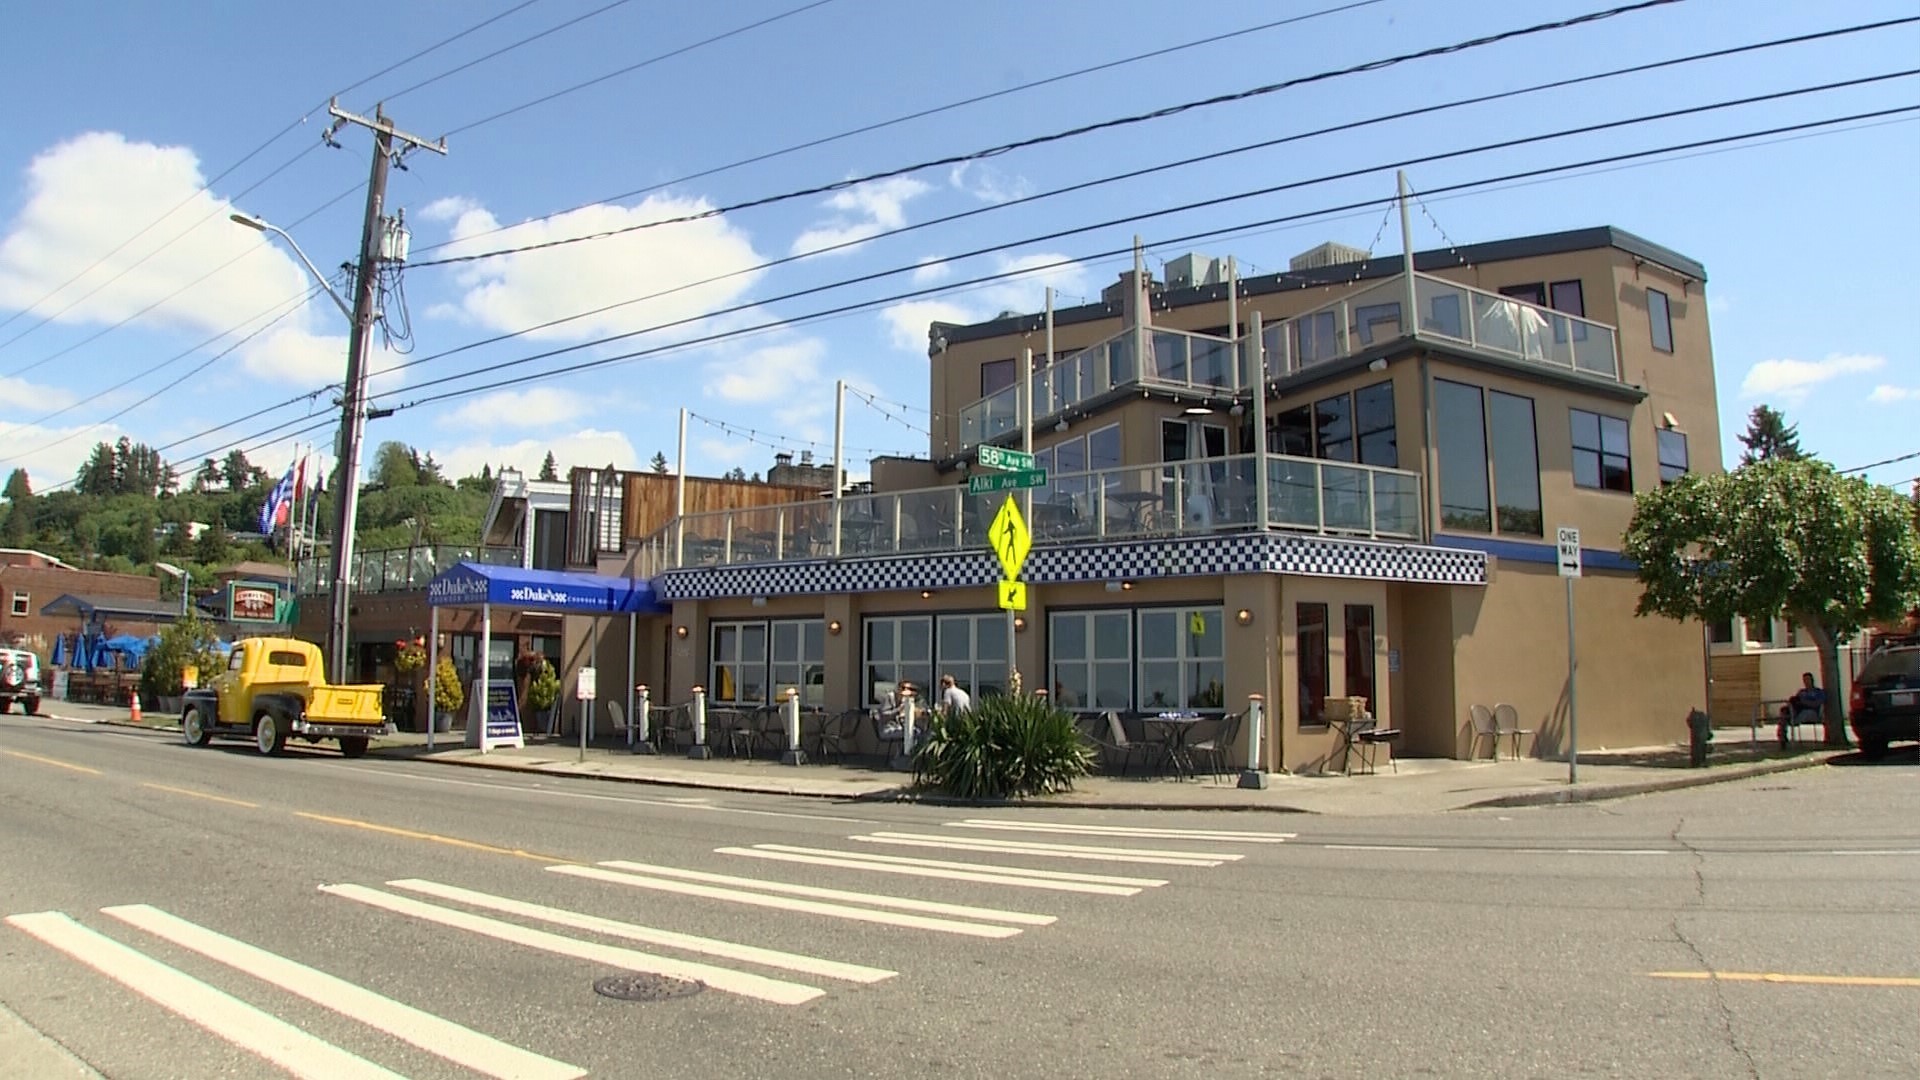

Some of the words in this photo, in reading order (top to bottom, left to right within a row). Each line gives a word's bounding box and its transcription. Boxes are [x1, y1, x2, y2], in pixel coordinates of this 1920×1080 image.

[981, 448, 1005, 465] 58th
[1006, 455, 1019, 467] Ave
[1021, 457, 1032, 468] SW
[972, 476, 994, 492] Alki
[1001, 478, 1017, 489] Ave
[1030, 474, 1044, 485] SW
[1560, 530, 1577, 543] ONE
[1561, 545, 1577, 557] WAY
[524, 586, 556, 602] Duke's
